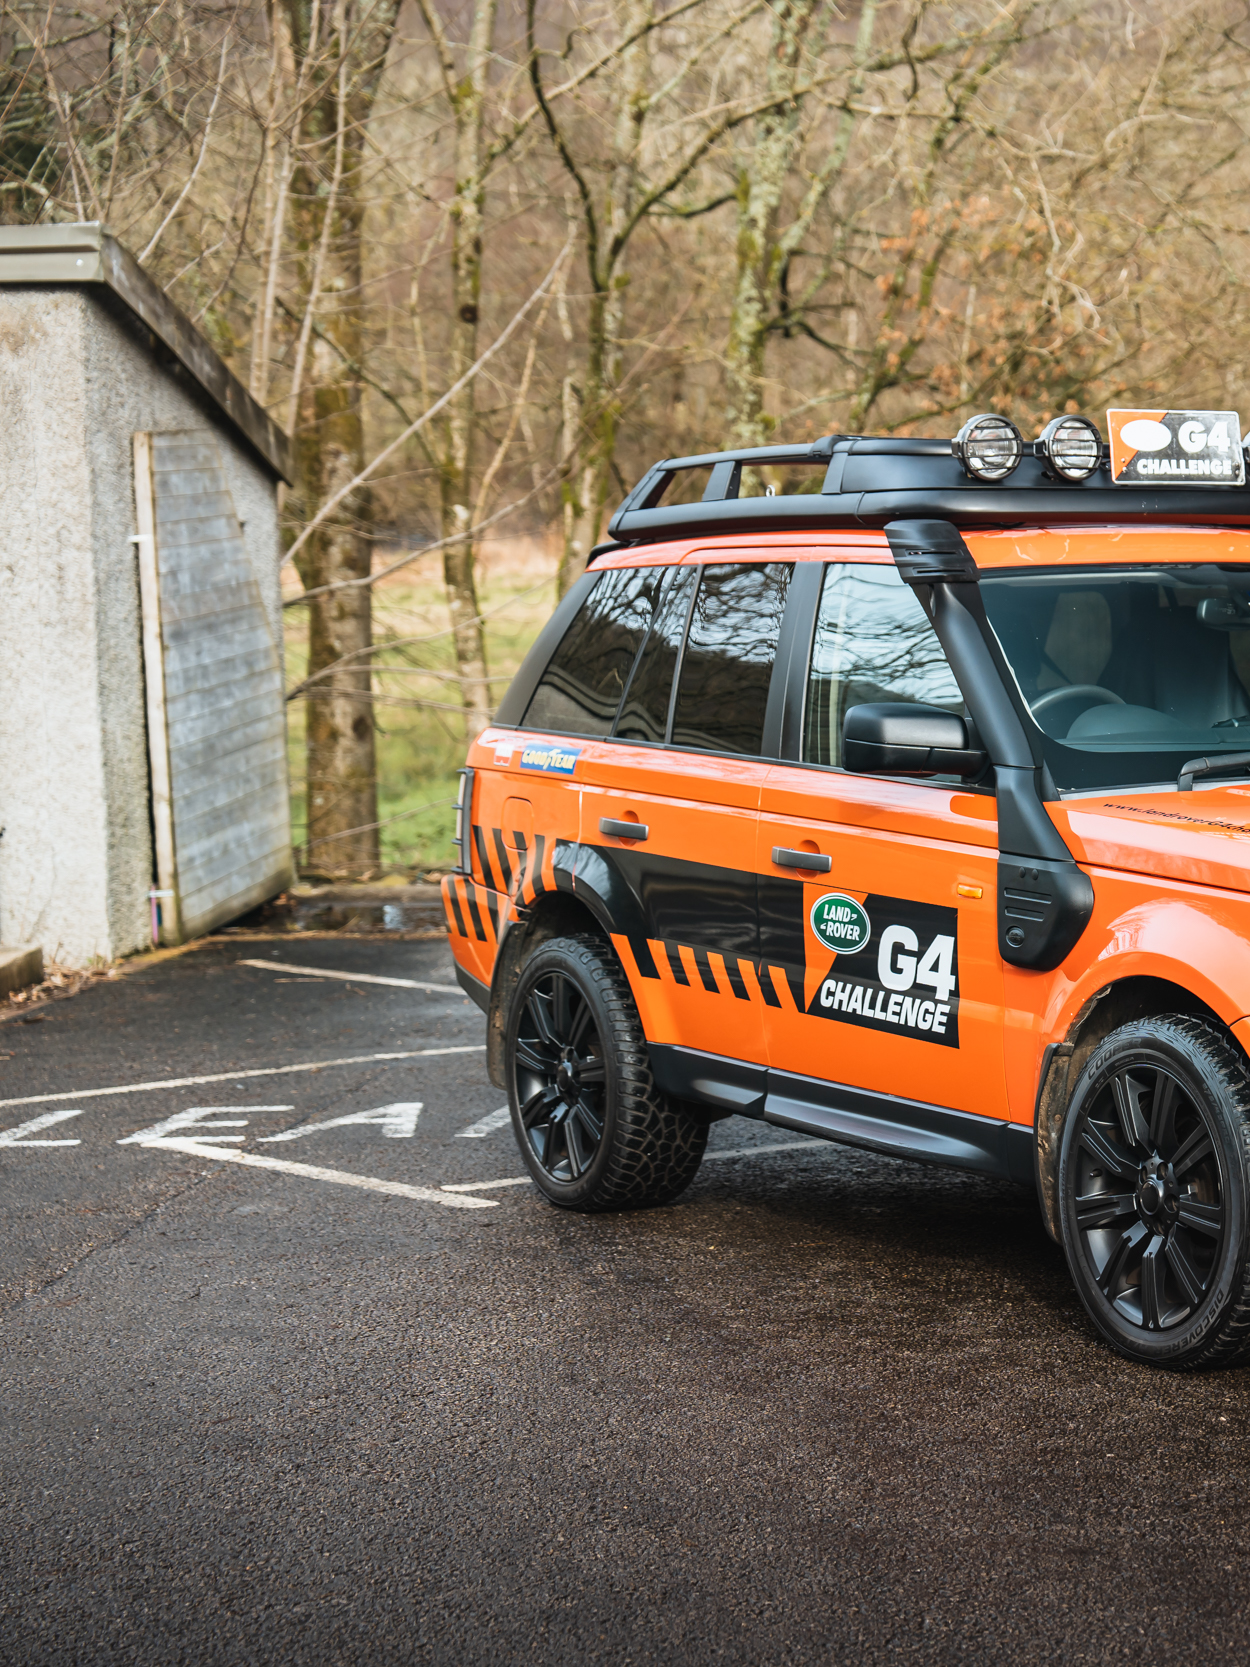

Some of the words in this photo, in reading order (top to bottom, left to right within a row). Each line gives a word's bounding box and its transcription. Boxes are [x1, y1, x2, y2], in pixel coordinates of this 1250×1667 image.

[1178, 420, 1231, 454] G4
[1136, 458, 1233, 475] CHALLENGE
[823, 904, 851, 922] LAND
[825, 921, 861, 941] ROVER
[877, 924, 956, 1002] G4
[819, 978, 951, 1034] CHALLENGE
[1087, 1037, 1143, 1081] COOPER
